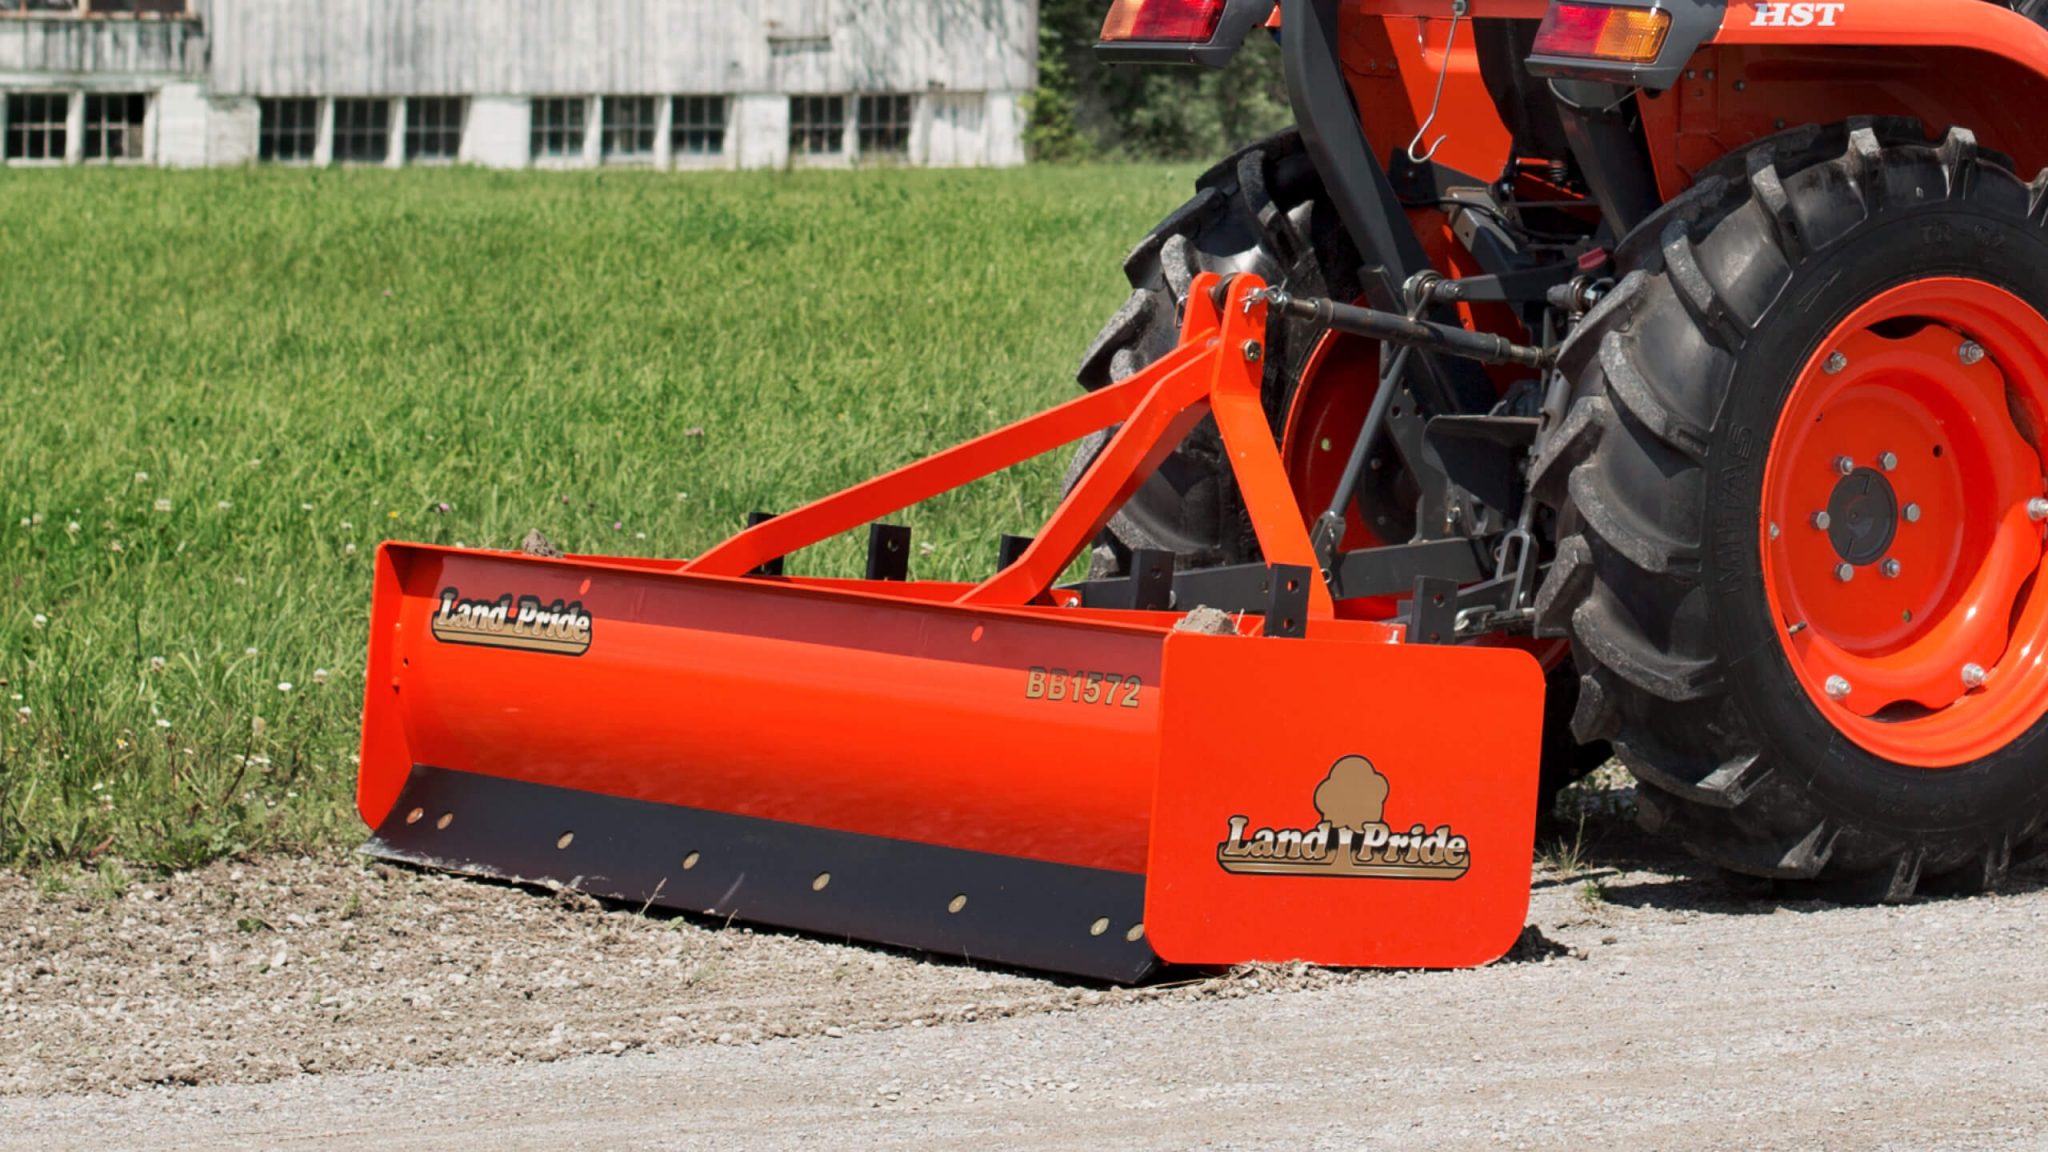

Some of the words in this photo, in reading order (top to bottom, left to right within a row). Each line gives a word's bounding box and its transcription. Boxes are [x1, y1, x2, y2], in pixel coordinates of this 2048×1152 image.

[1750, 2, 1845, 27] HST
[435, 588, 511, 632] Land
[513, 597, 592, 641] Pride
[1026, 666, 1142, 708] BB1572
[1223, 815, 1333, 860] Land
[1356, 822, 1470, 867] Pride
